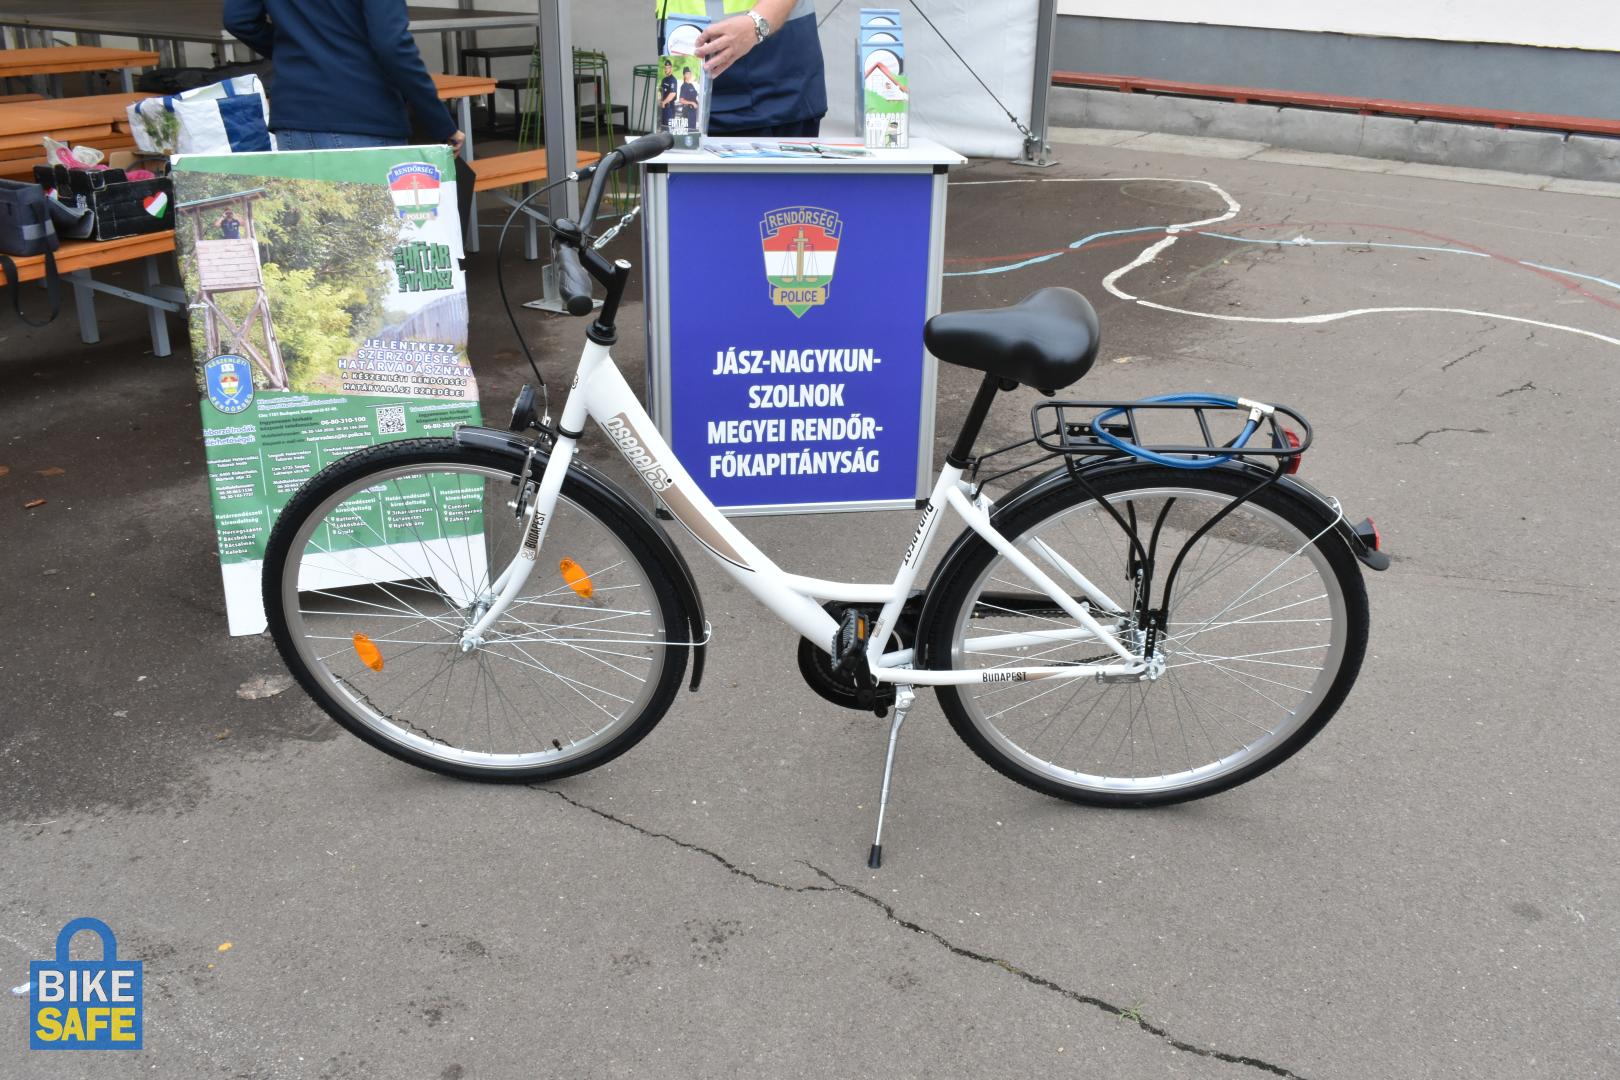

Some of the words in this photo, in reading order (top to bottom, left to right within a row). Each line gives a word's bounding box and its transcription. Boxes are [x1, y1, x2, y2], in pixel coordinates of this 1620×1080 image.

[393, 164, 434, 177] RENDŐRSÉG
[768, 207, 835, 229] RENDŐRSÉG
[780, 290, 817, 303] POLICE
[364, 339, 454, 354] JELENTKEZZ
[358, 350, 459, 365] SZERZŐDÉSES
[712, 347, 881, 375] JÁSZ-NAGYKUN-
[338, 359, 472, 377] HATÁRVADÁSZNAK
[352, 372, 409, 383] KÉSZENLÉTI
[411, 375, 467, 386] RENDŐRSÉG
[343, 383, 411, 394] HATÁRVADÁSZ
[413, 388, 465, 397] EZREDÉBE!
[748, 383, 845, 409] SZOLNOK
[707, 418, 786, 444] MEGYEI
[791, 413, 883, 441] RENDŐR-
[709, 448, 880, 478] FŐKAPITÁNYSÁG
[523, 511, 548, 549] BUDAPEST
[982, 671, 1027, 683] BUDAPEST
